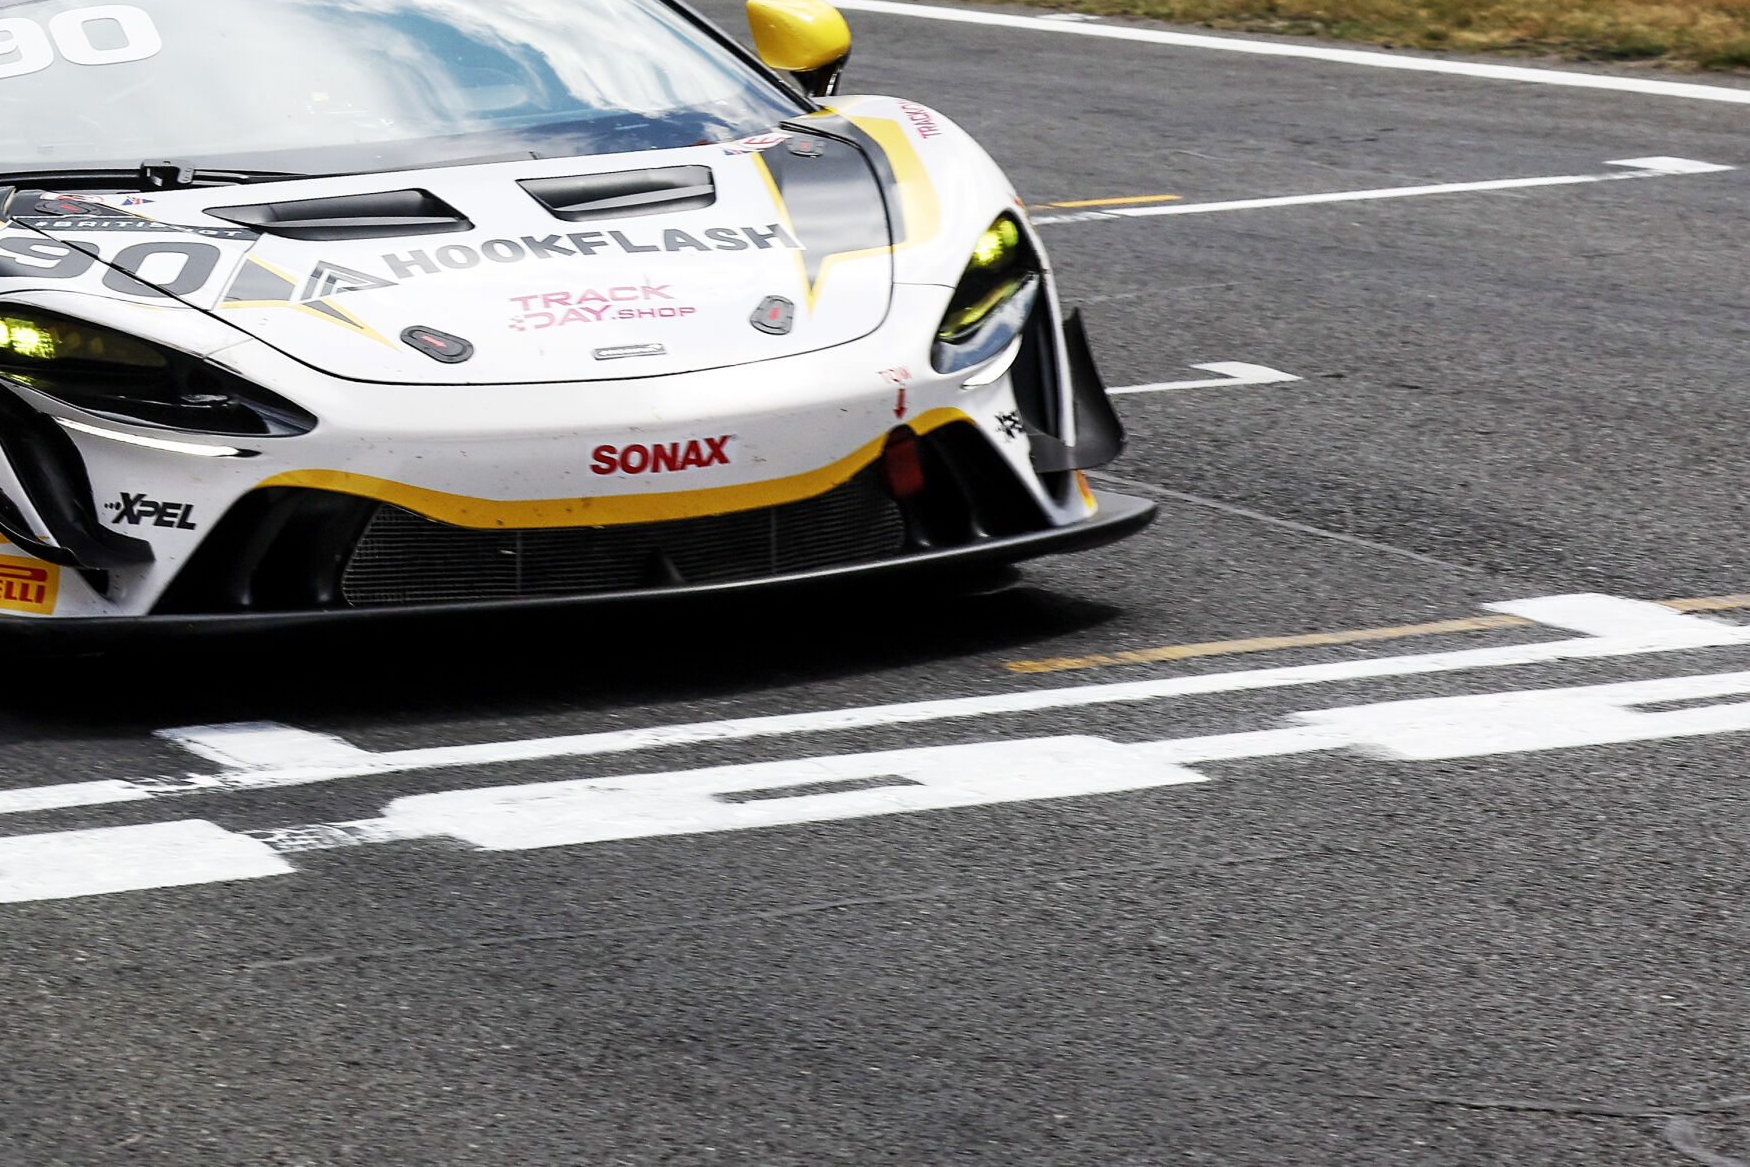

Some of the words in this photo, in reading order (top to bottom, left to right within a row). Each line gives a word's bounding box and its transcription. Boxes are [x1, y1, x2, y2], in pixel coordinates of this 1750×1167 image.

[35, 220, 242, 236] #BRITISGT
[381, 224, 806, 278] HOOKFLASH
[510, 285, 676, 311] TRACK
[591, 435, 731, 475] SONAX
[110, 492, 197, 530] XPEL
